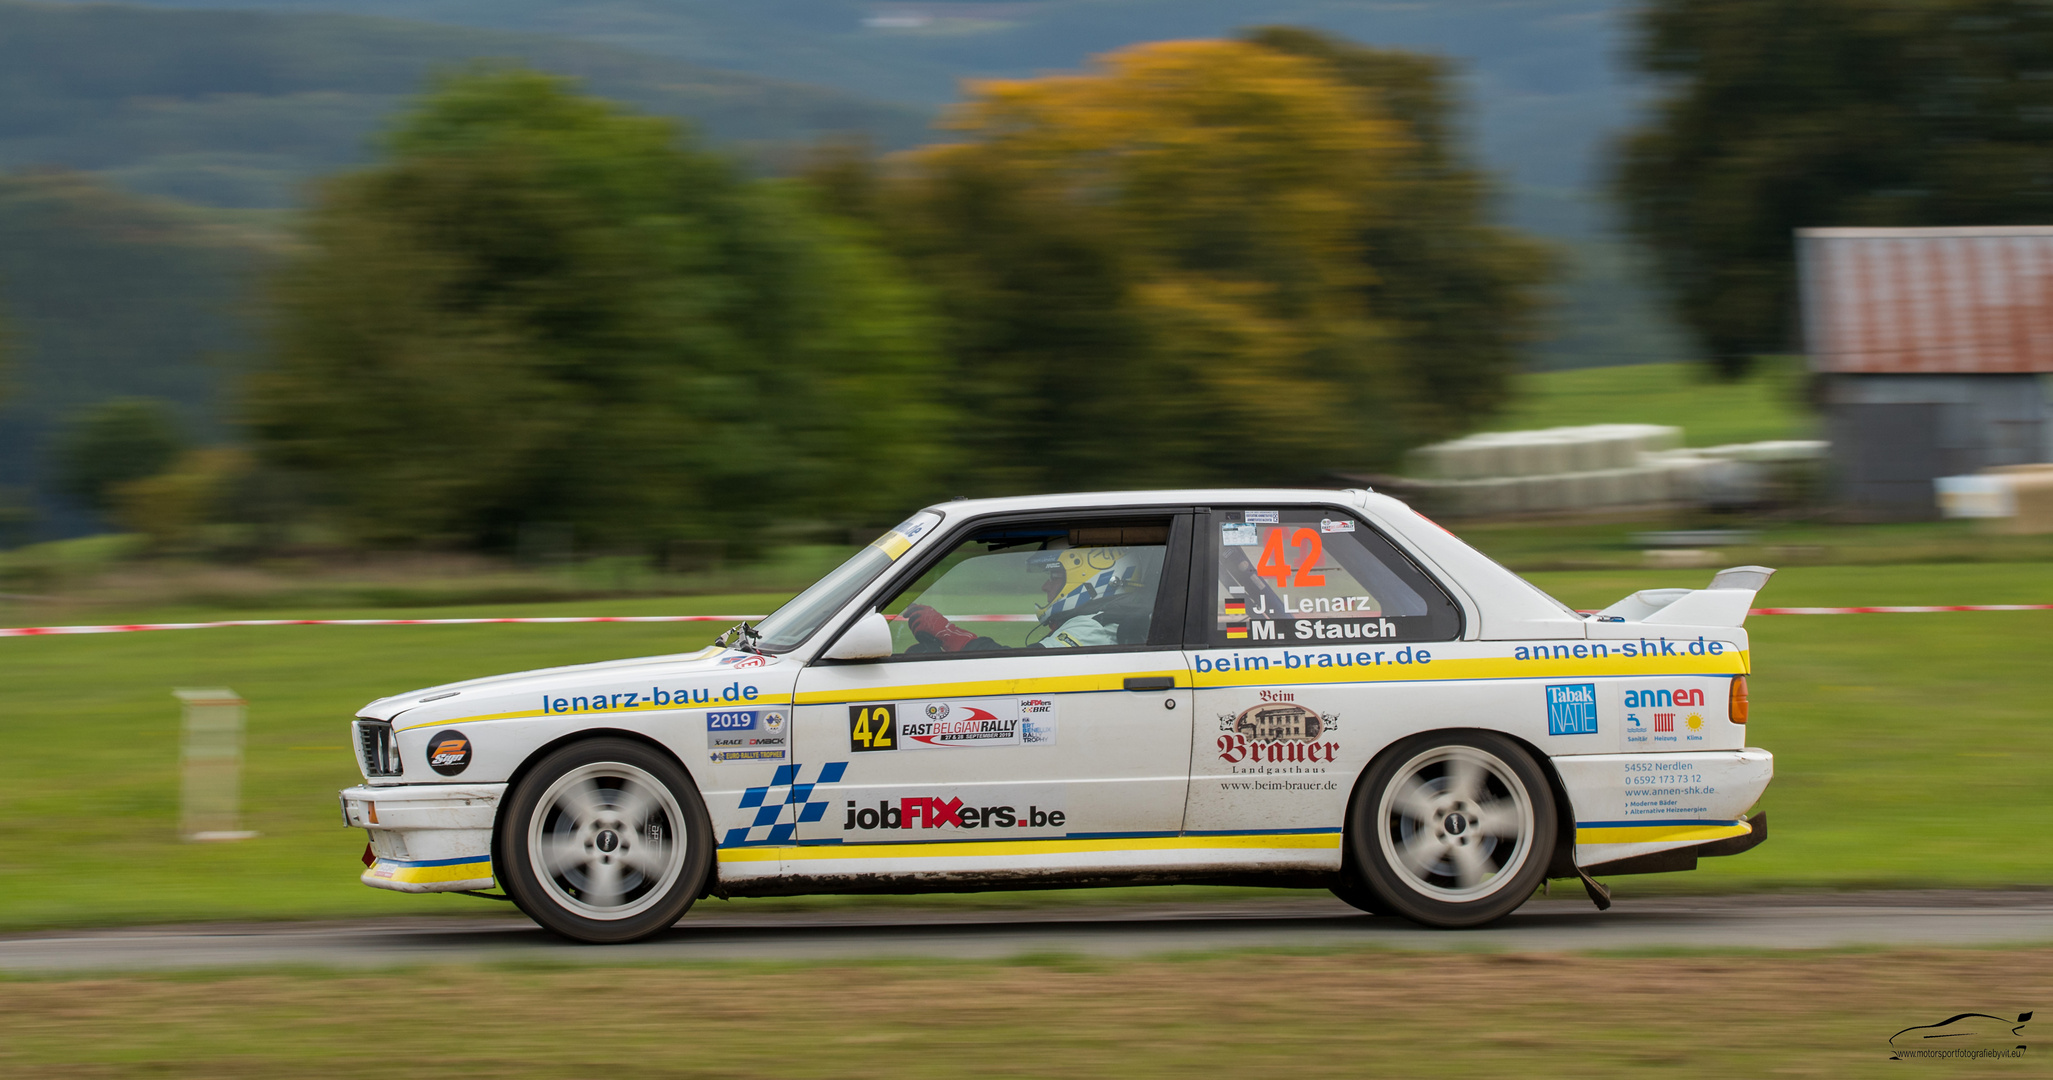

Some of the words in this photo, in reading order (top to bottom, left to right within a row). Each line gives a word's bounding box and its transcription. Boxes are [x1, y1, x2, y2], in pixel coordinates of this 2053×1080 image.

[1257, 527, 1326, 588] 42
[1252, 594, 1275, 614] J.
[1283, 594, 1371, 613] Lenarz
[1251, 620, 1285, 640] M.
[1294, 618, 1397, 639] Stauch
[1514, 636, 1724, 661] annen-shk.de
[1195, 646, 1432, 673] beim-brauer.de
[543, 682, 759, 714] lenarz-bau.de
[1259, 690, 1295, 702] Beim
[1548, 686, 1594, 703] Tabak
[1624, 688, 1705, 708] annen
[711, 713, 751, 728] 2019
[853, 707, 892, 748] 42
[1551, 702, 1596, 733] NATIE
[902, 723, 933, 736] EAST
[933, 721, 980, 735] BELGIAN
[981, 720, 1018, 732] RALLY
[1217, 734, 1340, 763] Brauer
[1232, 765, 1326, 775] Landgasthaus
[1624, 763, 1653, 772] 54552
[1655, 762, 1693, 771] Nerdlen
[1220, 780, 1338, 791] www.beim-brauer.de
[1634, 775, 1656, 785] 6592
[1659, 775, 1675, 784] 173
[1677, 774, 1689, 783] 73
[1691, 774, 1702, 783] 12
[1625, 785, 1715, 797] www.annen-shk.de
[843, 796, 1066, 830] jobFIXers.be
[1630, 807, 1665, 815] Alternative
